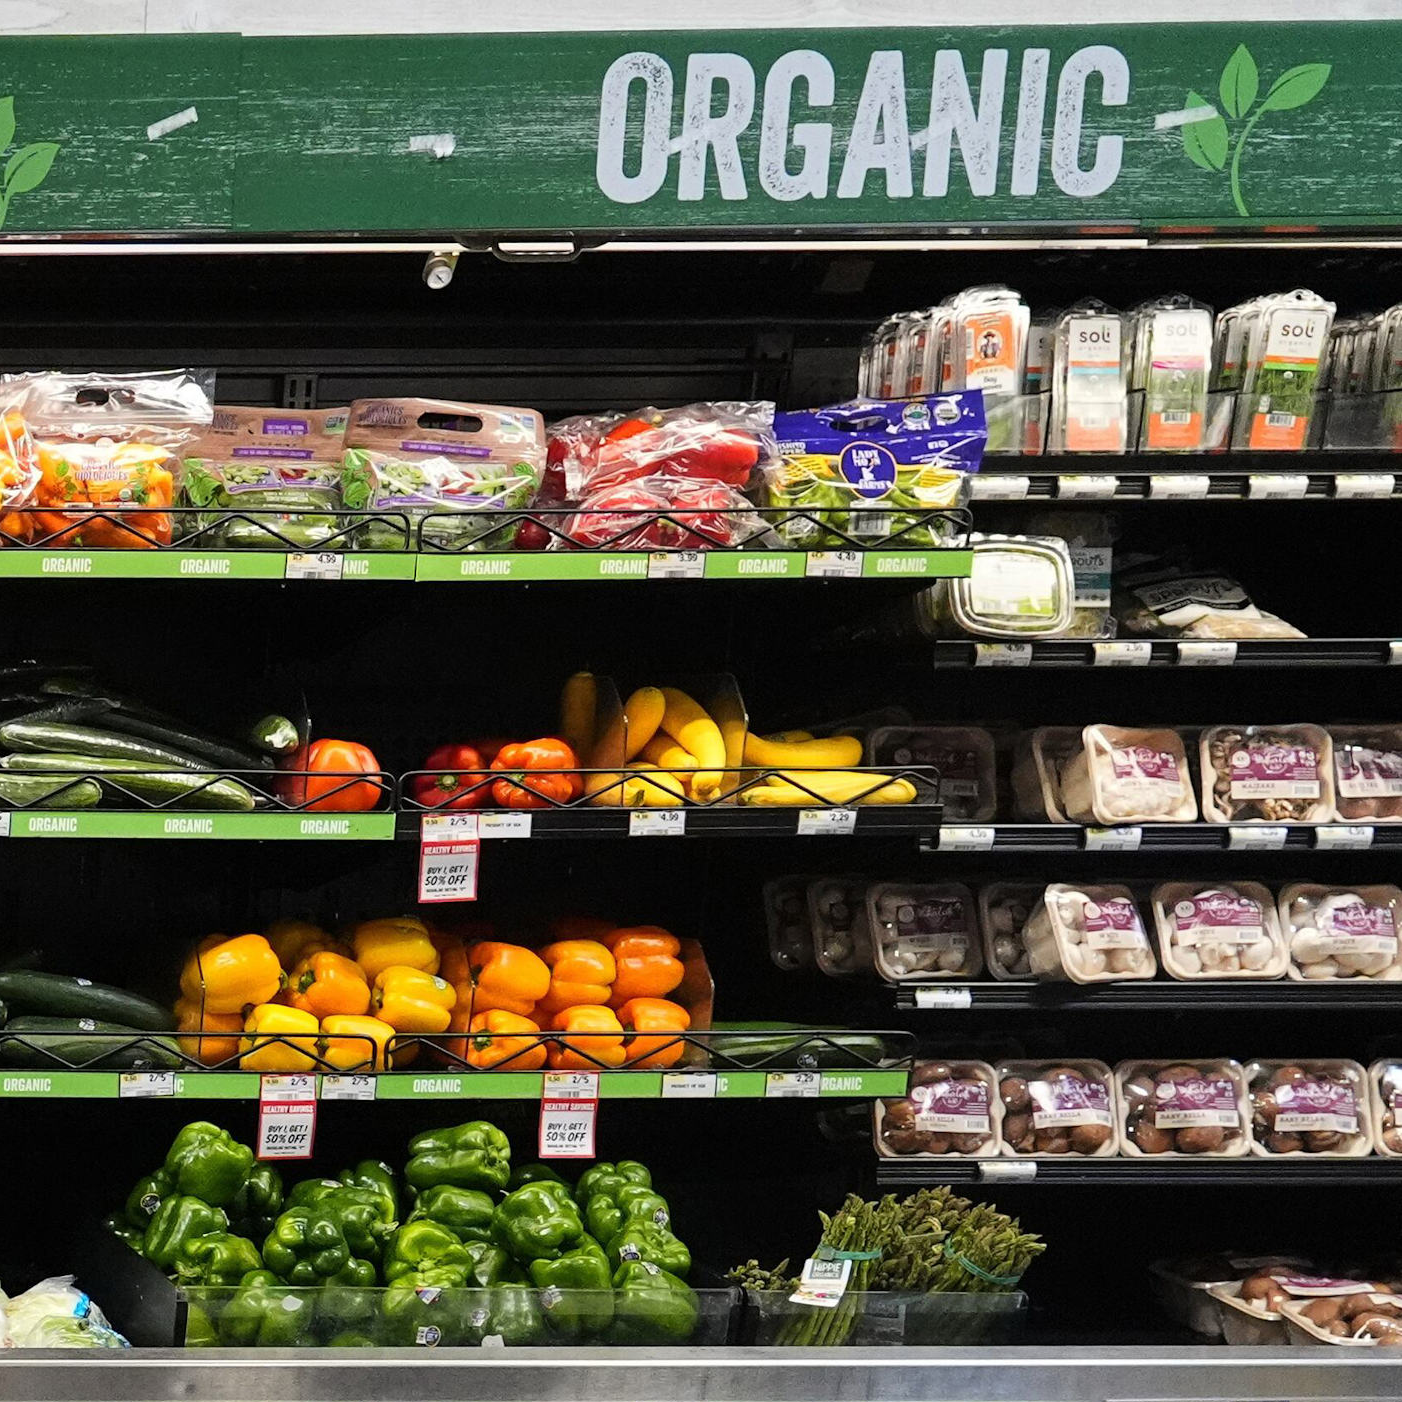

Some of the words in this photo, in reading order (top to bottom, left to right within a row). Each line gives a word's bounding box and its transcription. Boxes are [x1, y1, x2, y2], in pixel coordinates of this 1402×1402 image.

[595, 45, 1130, 203] ORGANIC
[42, 558, 92, 573] ORGANIC
[180, 559, 230, 574] ORGANIC
[343, 560, 369, 575] ANIC
[461, 560, 511, 575] ORGANIC
[738, 559, 788, 574] ORGANIC
[877, 558, 927, 573] ORGANIC
[28, 817, 77, 832] ORGANIC
[164, 818, 213, 834] ORGANIC
[300, 820, 349, 835] ORGANIC
[427, 866, 441, 875] BUY
[449, 865, 464, 874] GET
[425, 876, 446, 886] 50%
[448, 875, 468, 885] OFF
[3, 1077, 51, 1092] ORGANIC
[413, 1078, 461, 1093] ORGANIC
[820, 1076, 862, 1091] RGANIC
[265, 1134, 286, 1144] 50%
[288, 1134, 307, 1143] OFF
[546, 1132, 566, 1142] 50%
[568, 1132, 586, 1142] OFF
[814, 1262, 842, 1273] HIPPIE
